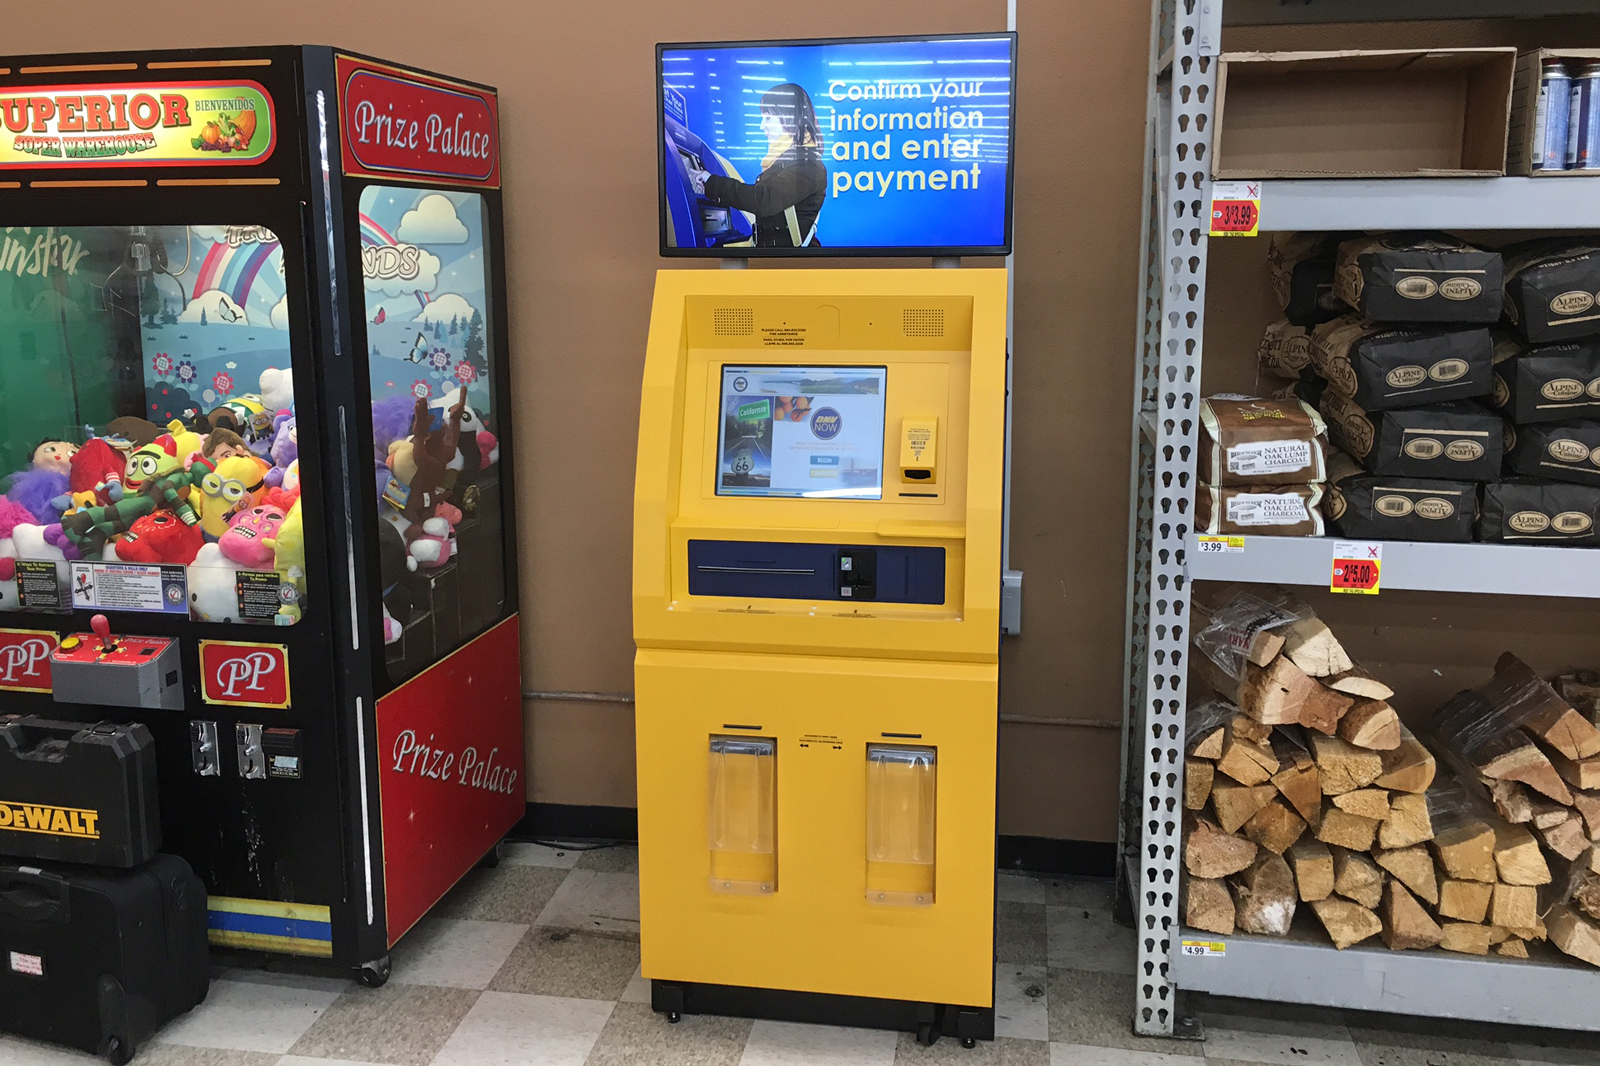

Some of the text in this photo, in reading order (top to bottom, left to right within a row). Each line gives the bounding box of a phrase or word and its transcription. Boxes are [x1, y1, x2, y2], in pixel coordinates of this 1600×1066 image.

[828, 81, 983, 103] Confirm your
[195, 98, 255, 112] BIENVENIDOS
[0, 93, 191, 133] UPERIOR
[830, 106, 983, 132] information
[355, 100, 489, 160] Prize Palace
[13, 133, 157, 158] SUPER WAREHOUSE
[831, 133, 983, 161] and enter
[832, 164, 981, 198] payment
[1556, 296, 1588, 307] ALPINE
[1391, 369, 1421, 380] ALPINE
[1547, 383, 1578, 392] ALPINE
[740, 405, 767, 417] California
[814, 423, 838, 432] NOW
[1264, 445, 1307, 454] NATURAL
[1554, 442, 1584, 454] ALPINE
[735, 461, 749, 472] 66
[1264, 457, 1307, 466] CHARCOAL
[1514, 515, 1544, 523] ALPINE
[1201, 542, 1222, 551] $3.99
[217, 652, 276, 696] PP
[392, 729, 517, 795] Prize Palace
[0, 804, 98, 835] DEWALT
[1185, 946, 1204, 955] $4.99
